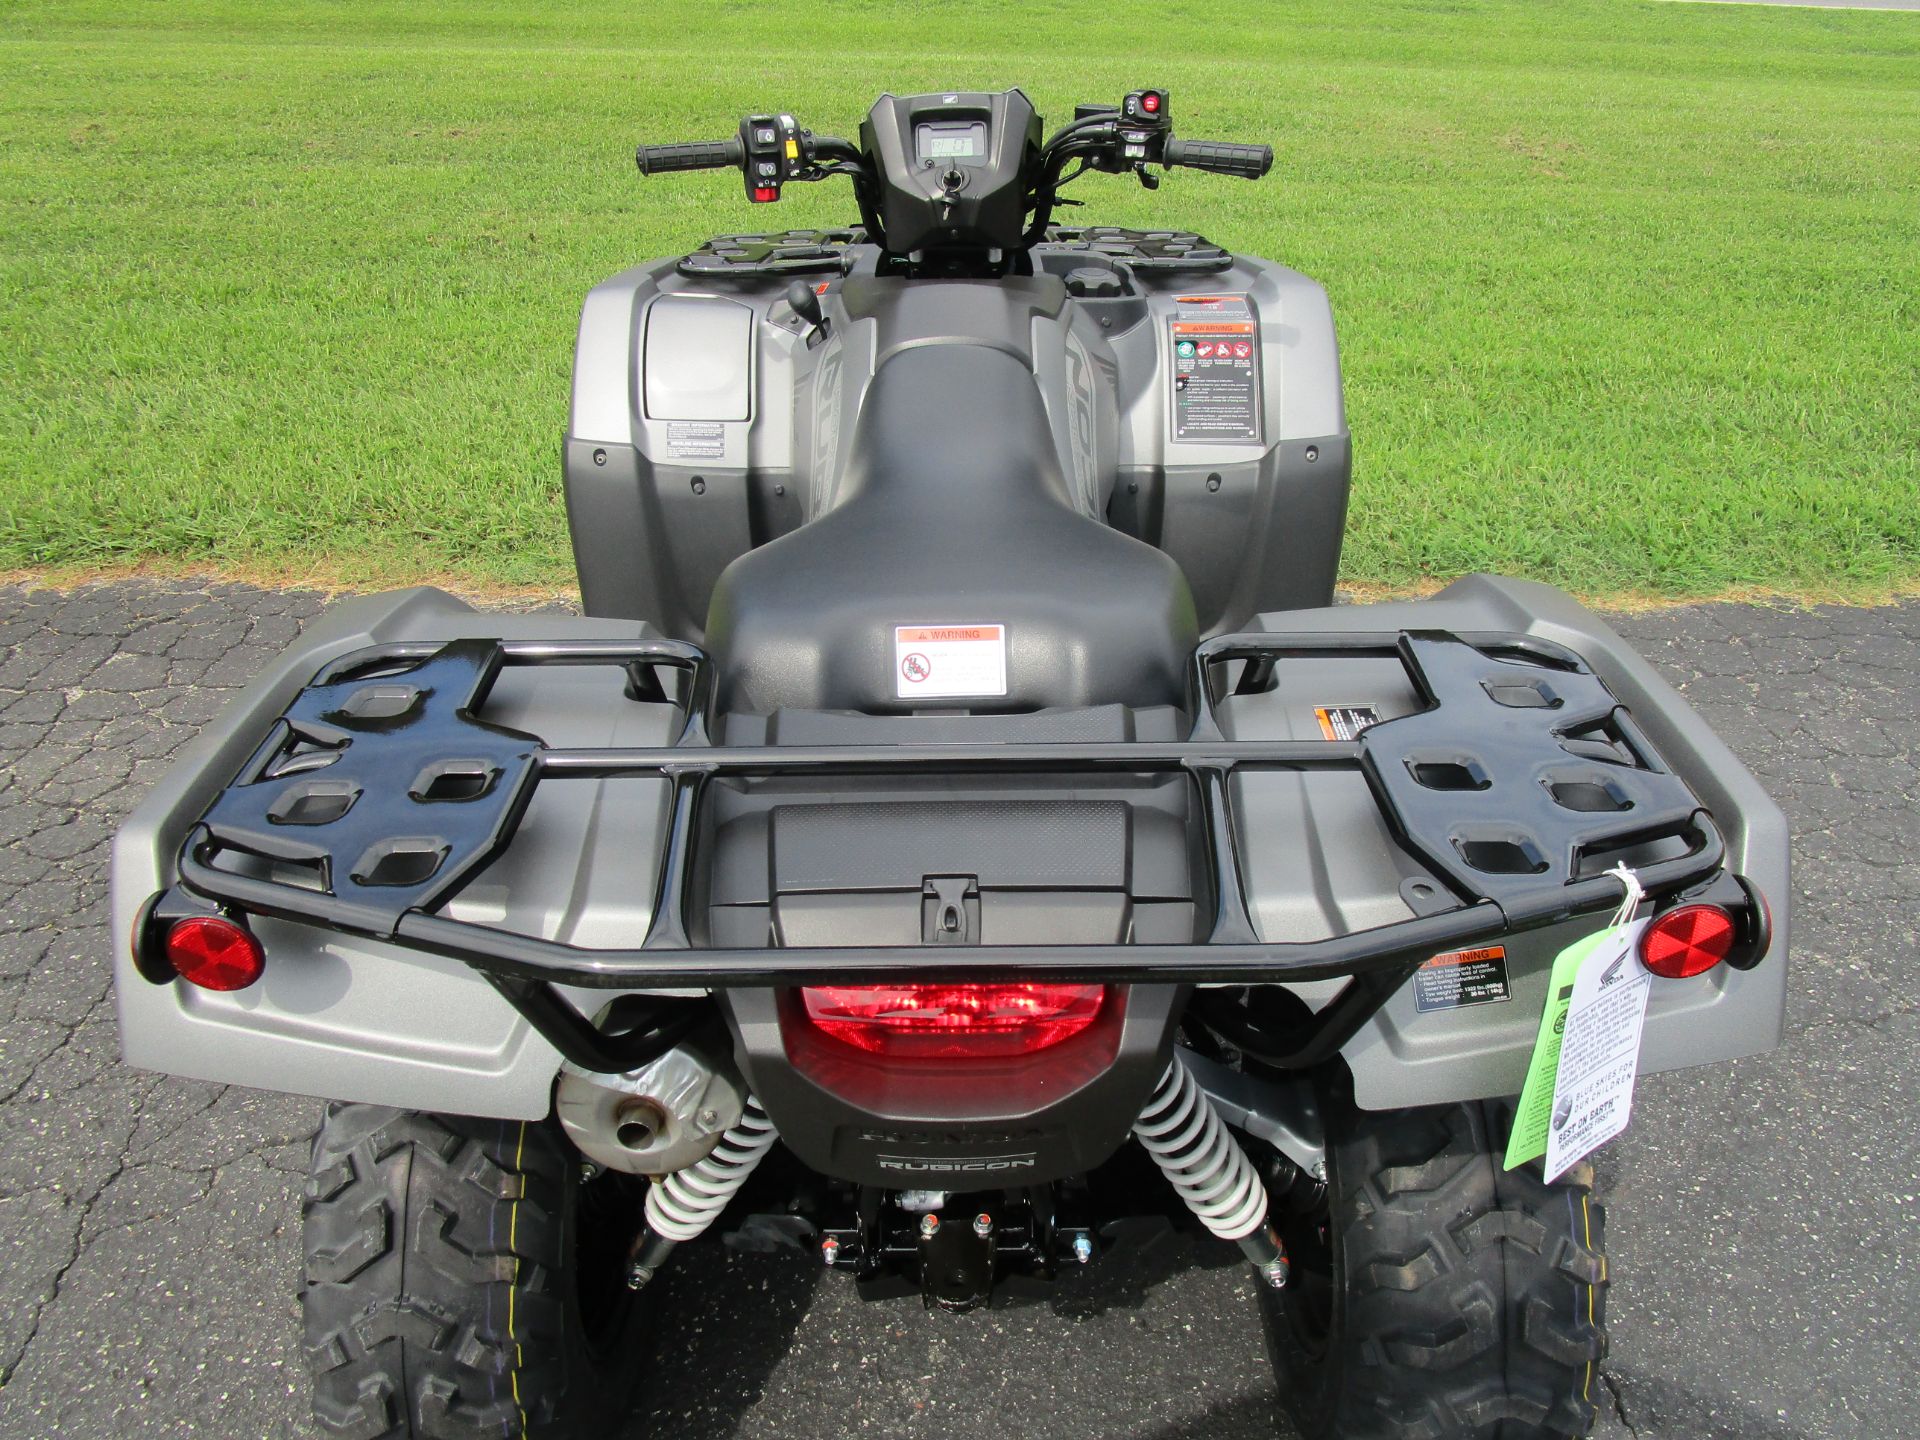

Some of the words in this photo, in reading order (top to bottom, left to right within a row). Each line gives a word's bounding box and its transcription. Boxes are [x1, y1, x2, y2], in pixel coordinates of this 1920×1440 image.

[931, 630, 980, 640] WARNING
[1436, 950, 1489, 964] WARNING
[1574, 1097, 1588, 1112] OUR
[1591, 1072, 1631, 1100] CHILDREN
[1575, 1083, 1593, 1100] BLUE
[1595, 1069, 1616, 1087] SKIES
[1619, 1060, 1632, 1071] FOR
[1558, 1123, 1576, 1143] BEST
[1578, 1115, 1587, 1128] ON
[1559, 1122, 1592, 1149] PERFORMANCE
[878, 1158, 1035, 1171] RUBICON
